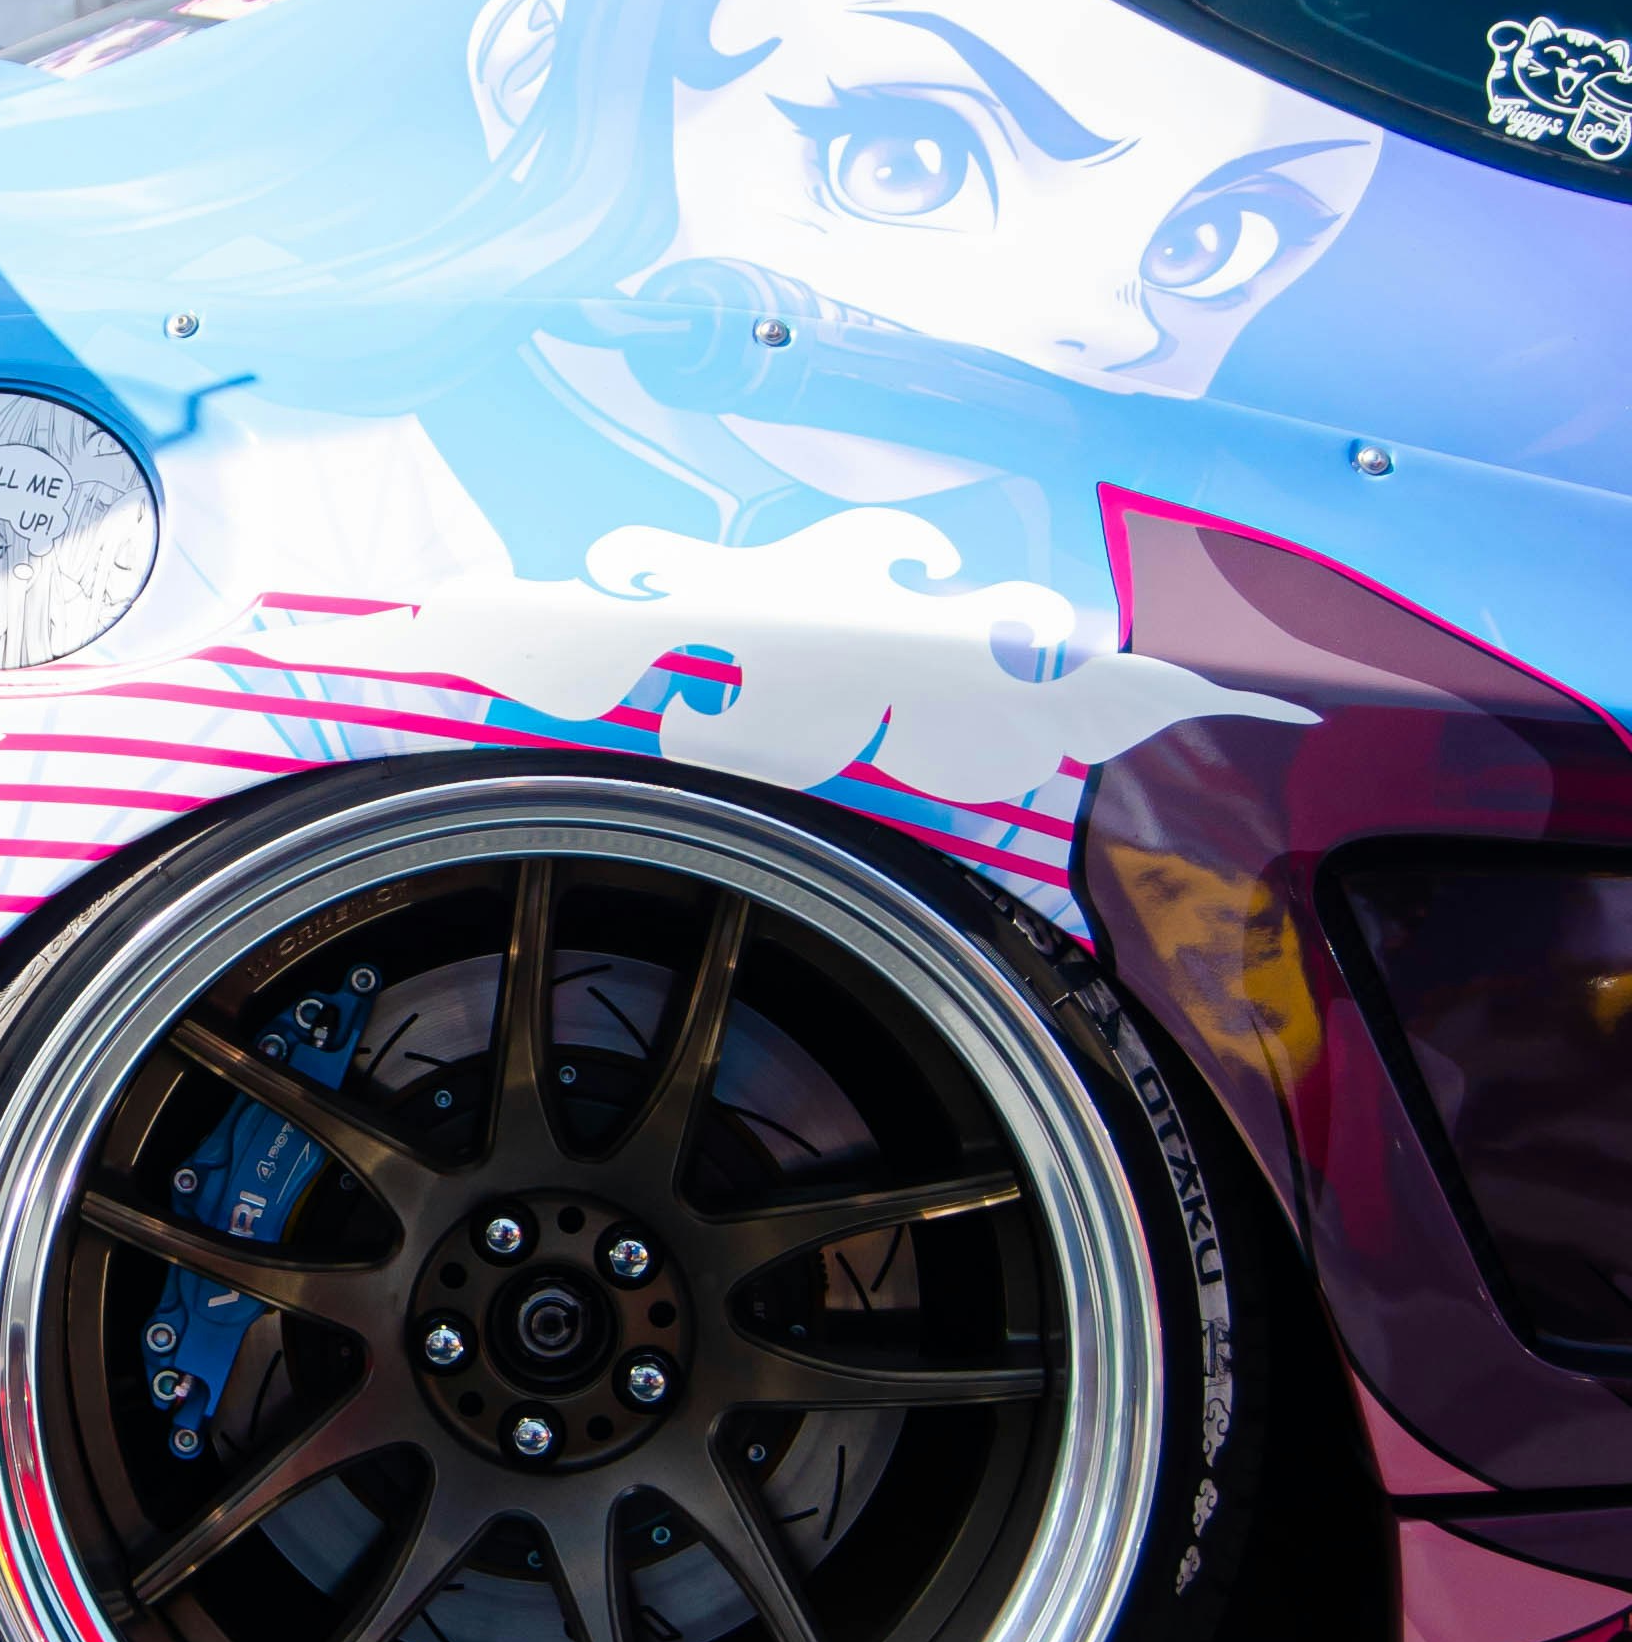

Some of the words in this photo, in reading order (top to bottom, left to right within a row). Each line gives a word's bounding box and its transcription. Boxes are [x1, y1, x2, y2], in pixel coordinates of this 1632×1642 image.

[25, 473, 64, 499] ME
[18, 509, 54, 536] UP!
[256, 1159, 278, 1182] 4
[1134, 1065, 1224, 1287] OTAKU
